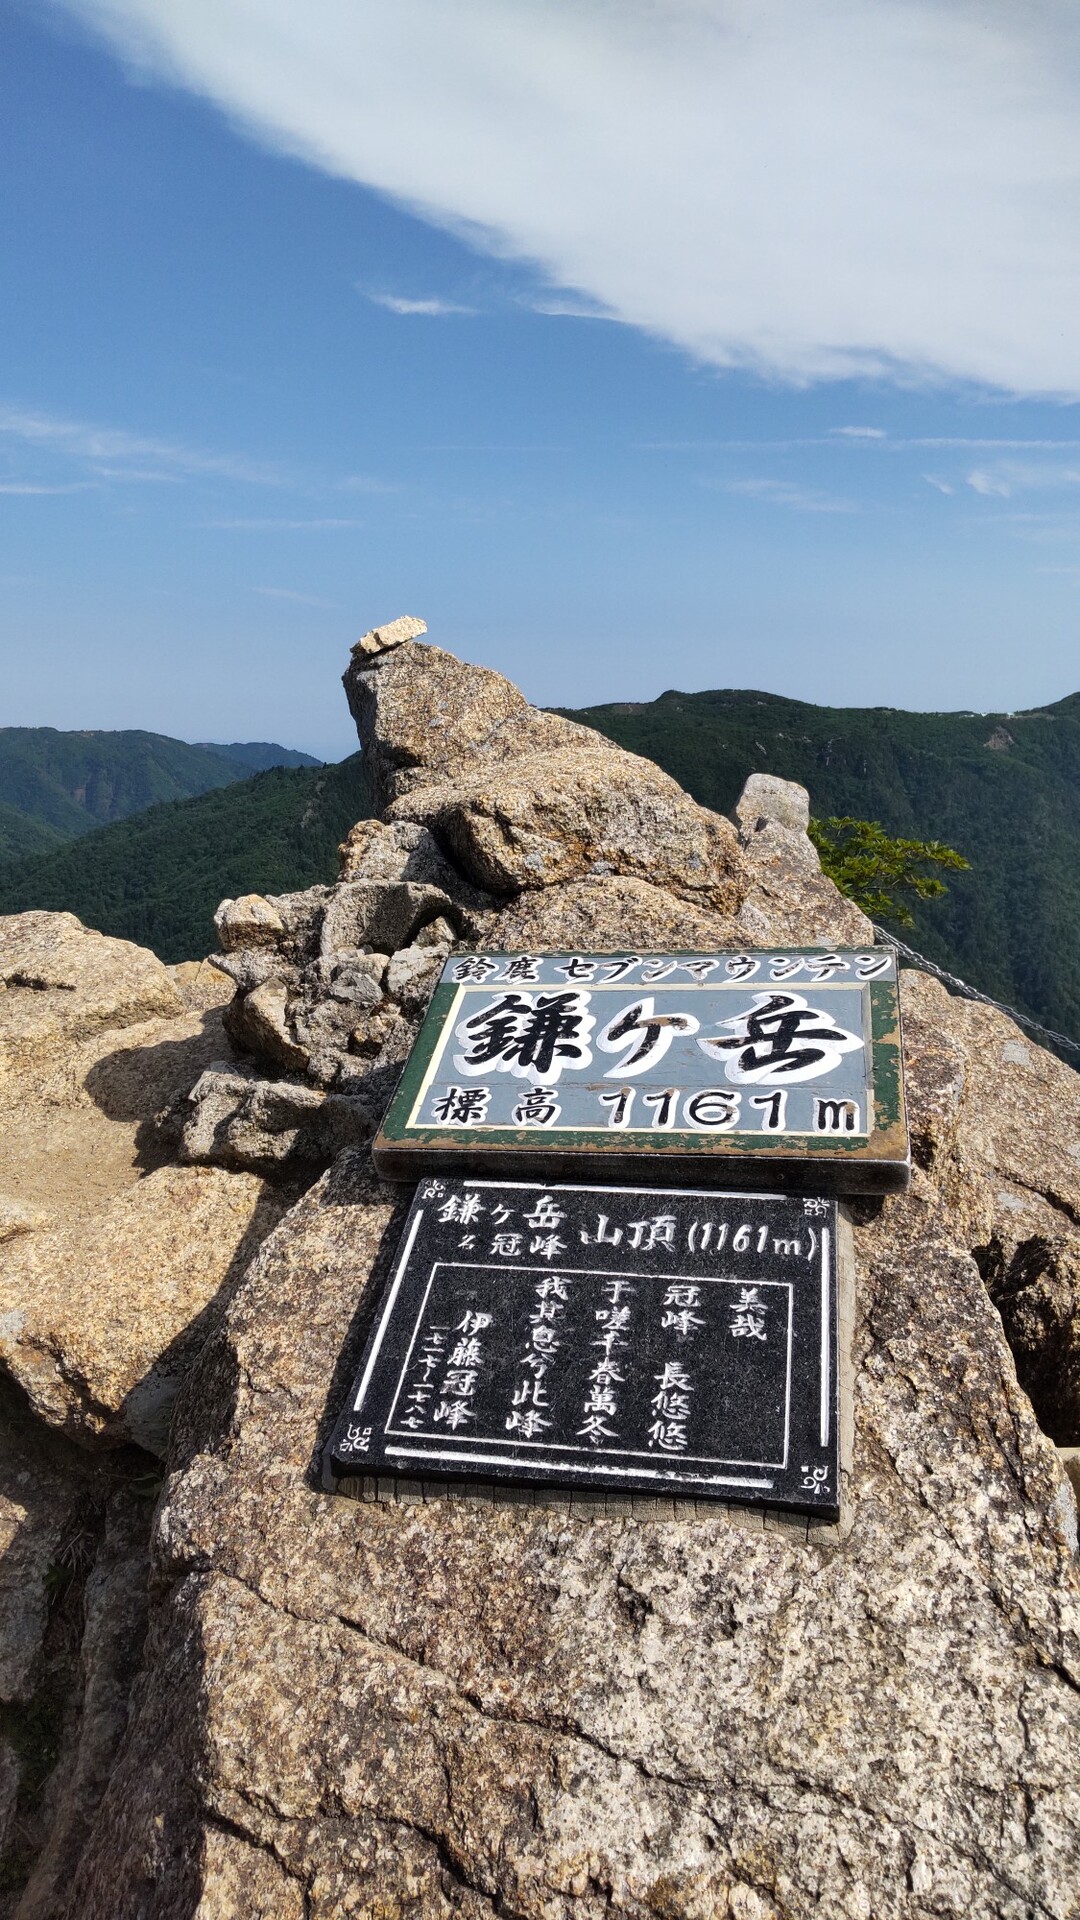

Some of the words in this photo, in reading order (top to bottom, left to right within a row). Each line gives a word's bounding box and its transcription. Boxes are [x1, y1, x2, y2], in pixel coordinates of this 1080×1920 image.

[453, 956, 543, 983] 鈴鹿
[555, 955, 893, 984] セブンマウンテン
[432, 1087, 560, 1126] 標高
[729, 1287, 769, 1341] 美哉
[433, 1310, 493, 1430] 伊藤冠峰
